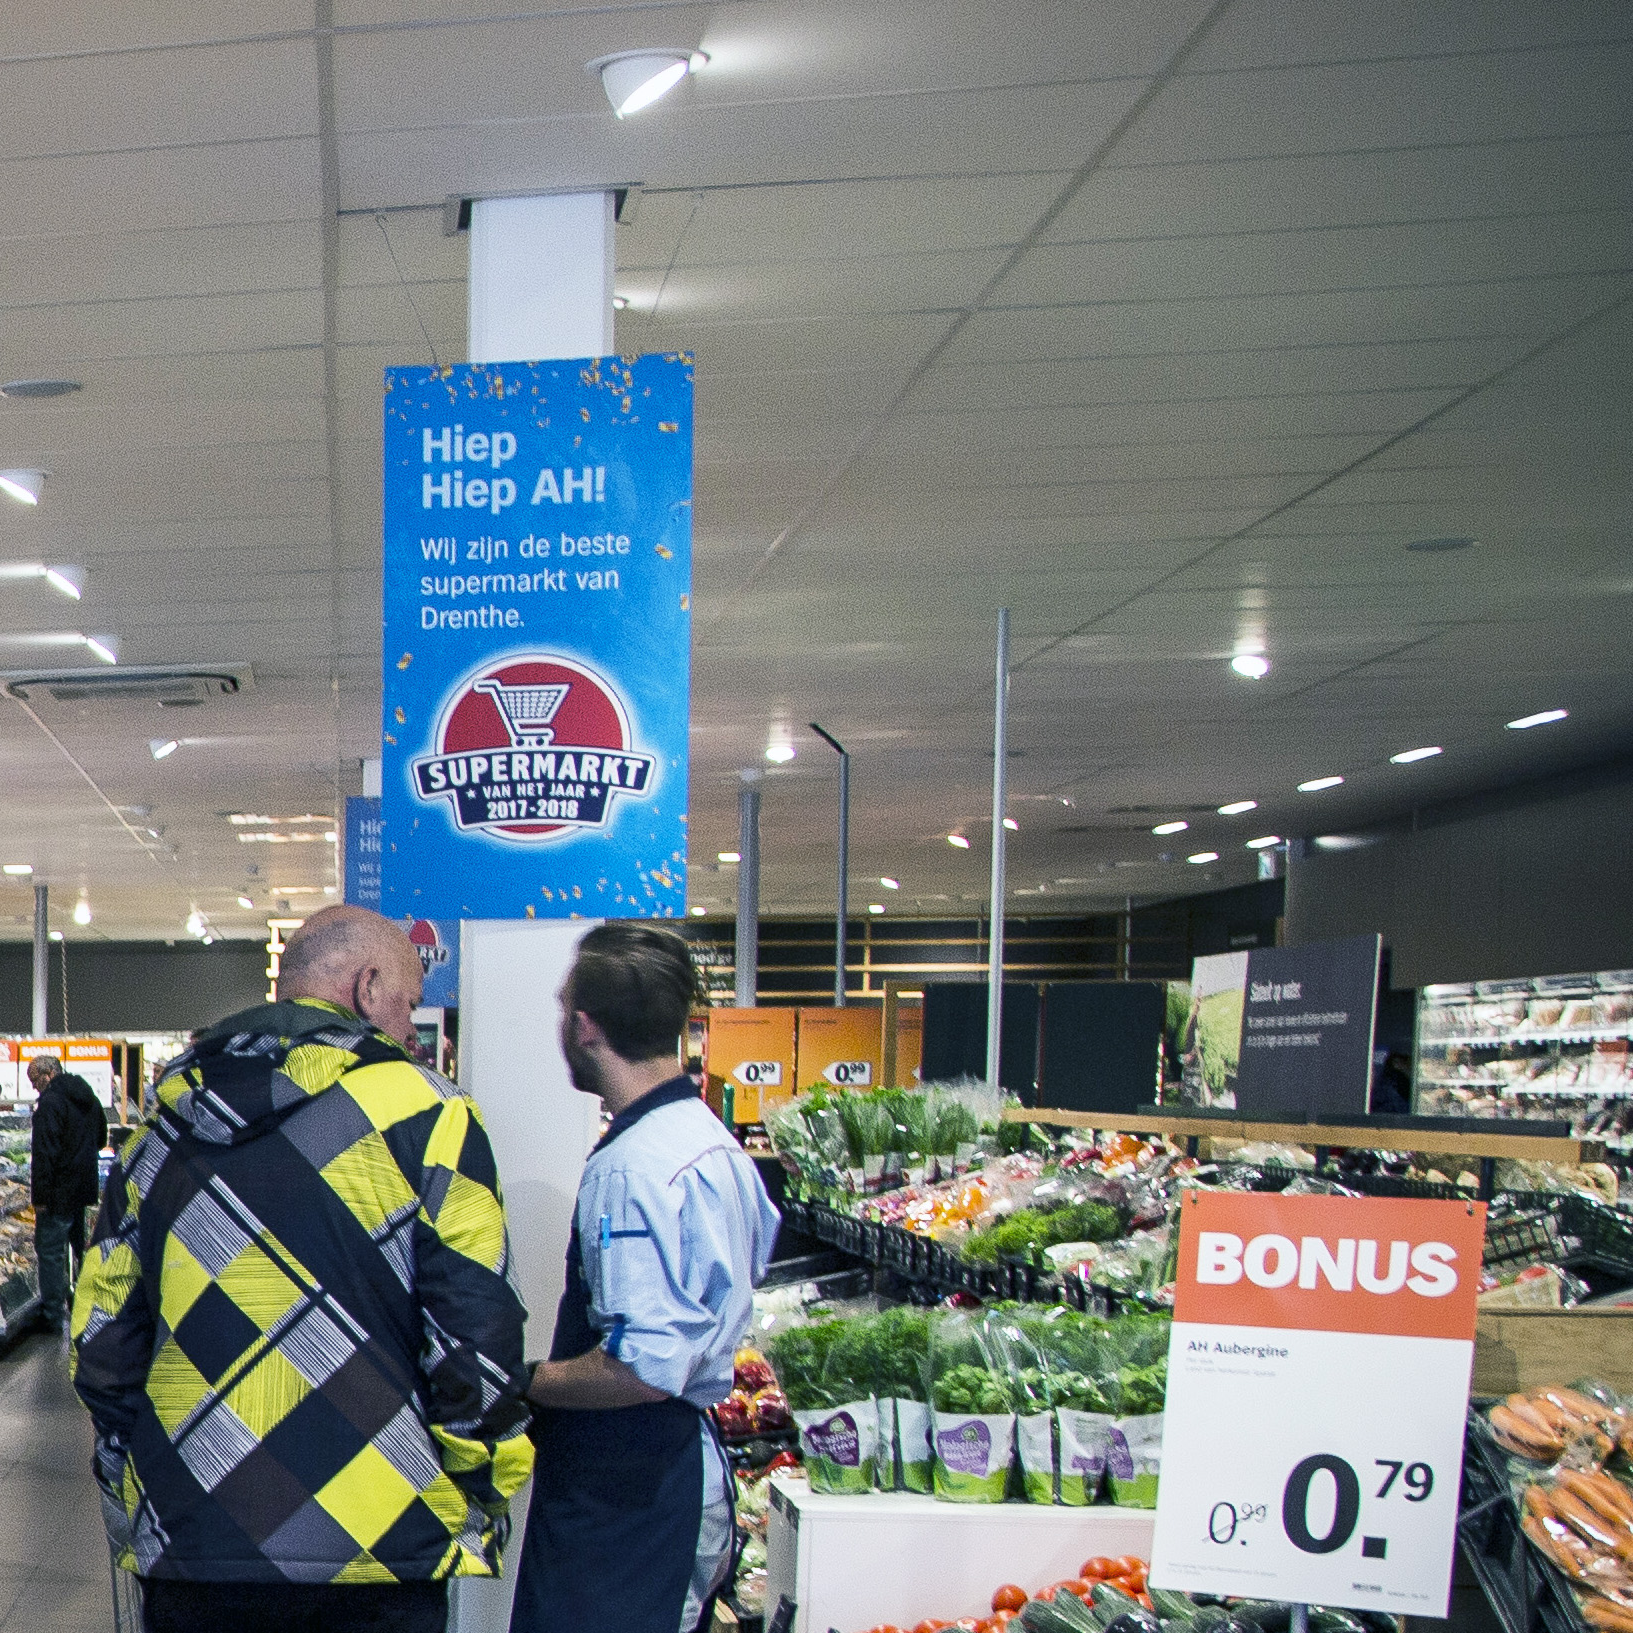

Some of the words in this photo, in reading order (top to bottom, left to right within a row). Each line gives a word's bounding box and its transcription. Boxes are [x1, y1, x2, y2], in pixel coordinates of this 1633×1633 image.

[423, 424, 517, 469] Hiep
[422, 470, 517, 514] Hiep
[531, 466, 606, 505] AH!
[421, 537, 456, 566] Wij
[466, 536, 508, 564] zijn
[519, 533, 550, 558] de
[561, 531, 631, 556] beste
[421, 568, 567, 599] supermarkt
[575, 570, 619, 590] van
[421, 604, 524, 630] Drenthe.
[428, 753, 643, 789] SUPERMARKT
[482, 785, 511, 799] VAN
[516, 784, 544, 797] HET
[550, 784, 585, 798] JAAR
[487, 799, 579, 819] 2017-2018
[745, 1063, 775, 1082] 0.99
[834, 1063, 865, 1083] 0.99
[1196, 1231, 1458, 1297] BONUS
[1187, 1340, 1209, 1353] AH
[1214, 1341, 1289, 1360] Aubergine
[1208, 1501, 1269, 1545] 0.99
[1282, 1453, 1434, 1560] 0.79
